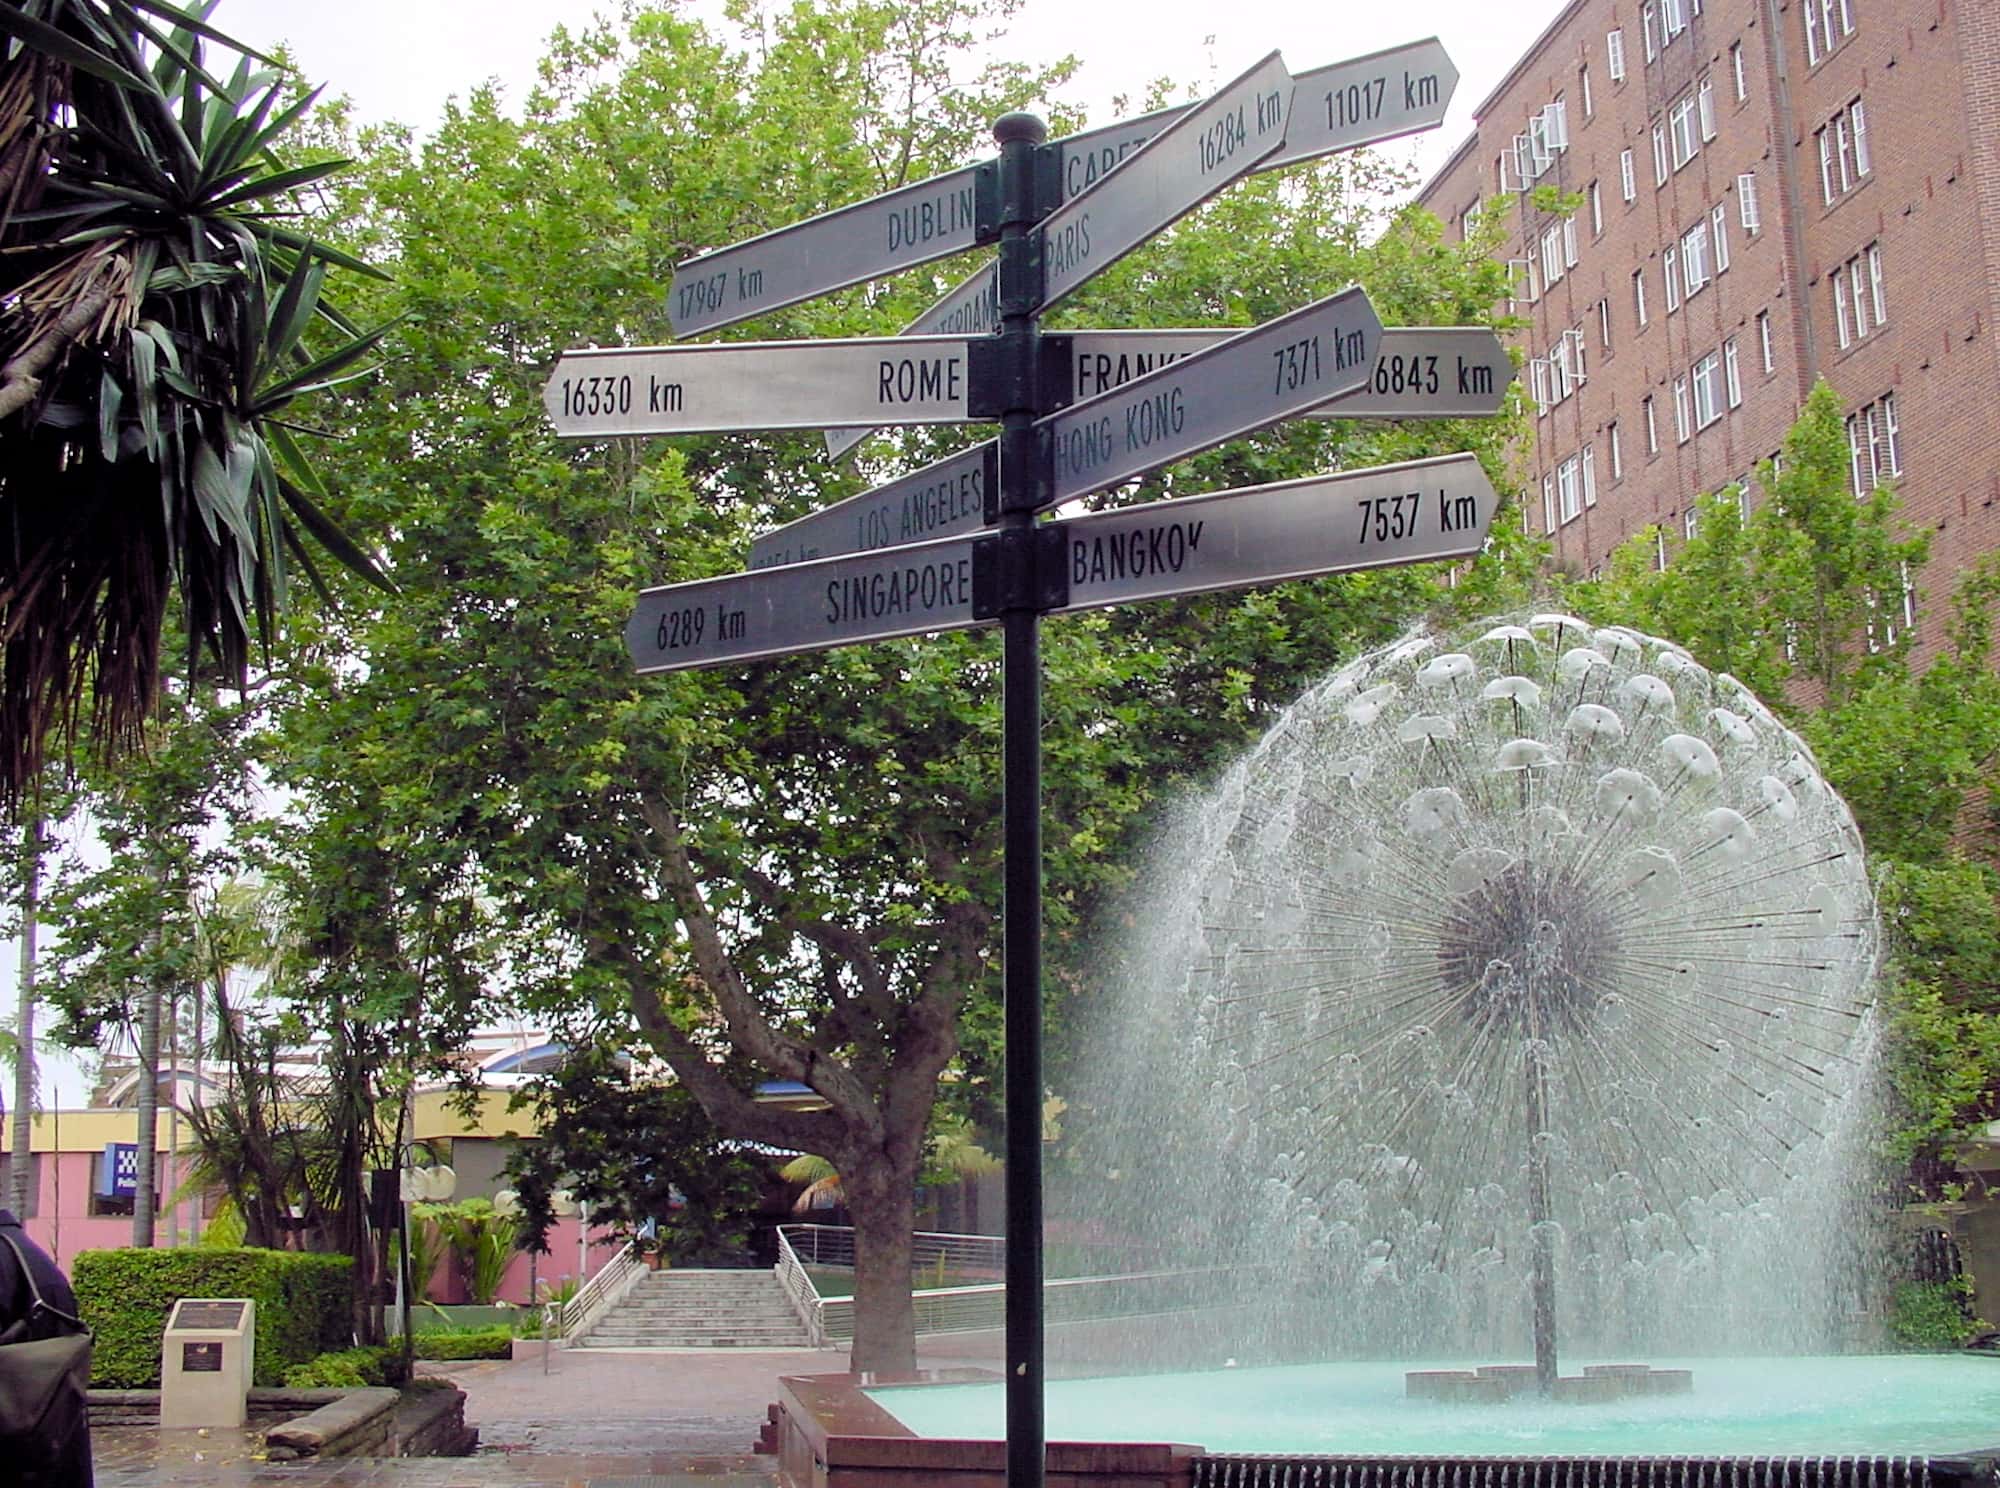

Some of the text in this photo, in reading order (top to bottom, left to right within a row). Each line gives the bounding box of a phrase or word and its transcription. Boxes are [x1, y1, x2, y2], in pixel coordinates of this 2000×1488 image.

[1325, 77, 1386, 130] 11017
[1404, 71, 1439, 111] km
[1046, 91, 1280, 281] PARIS 16284 km
[679, 187, 973, 320] 17967 km DUBLIN
[562, 358, 960, 416] 16330 km ROME
[1055, 327, 1364, 481] HONG KONG 7371 km
[1078, 353, 1193, 397] FRAN
[1457, 355, 1493, 394] km
[858, 469, 983, 551] LOS ANGELES
[1358, 492, 1420, 544] 7537
[1440, 489, 1476, 532] km
[657, 559, 969, 650] 6289 km SINGAPORE
